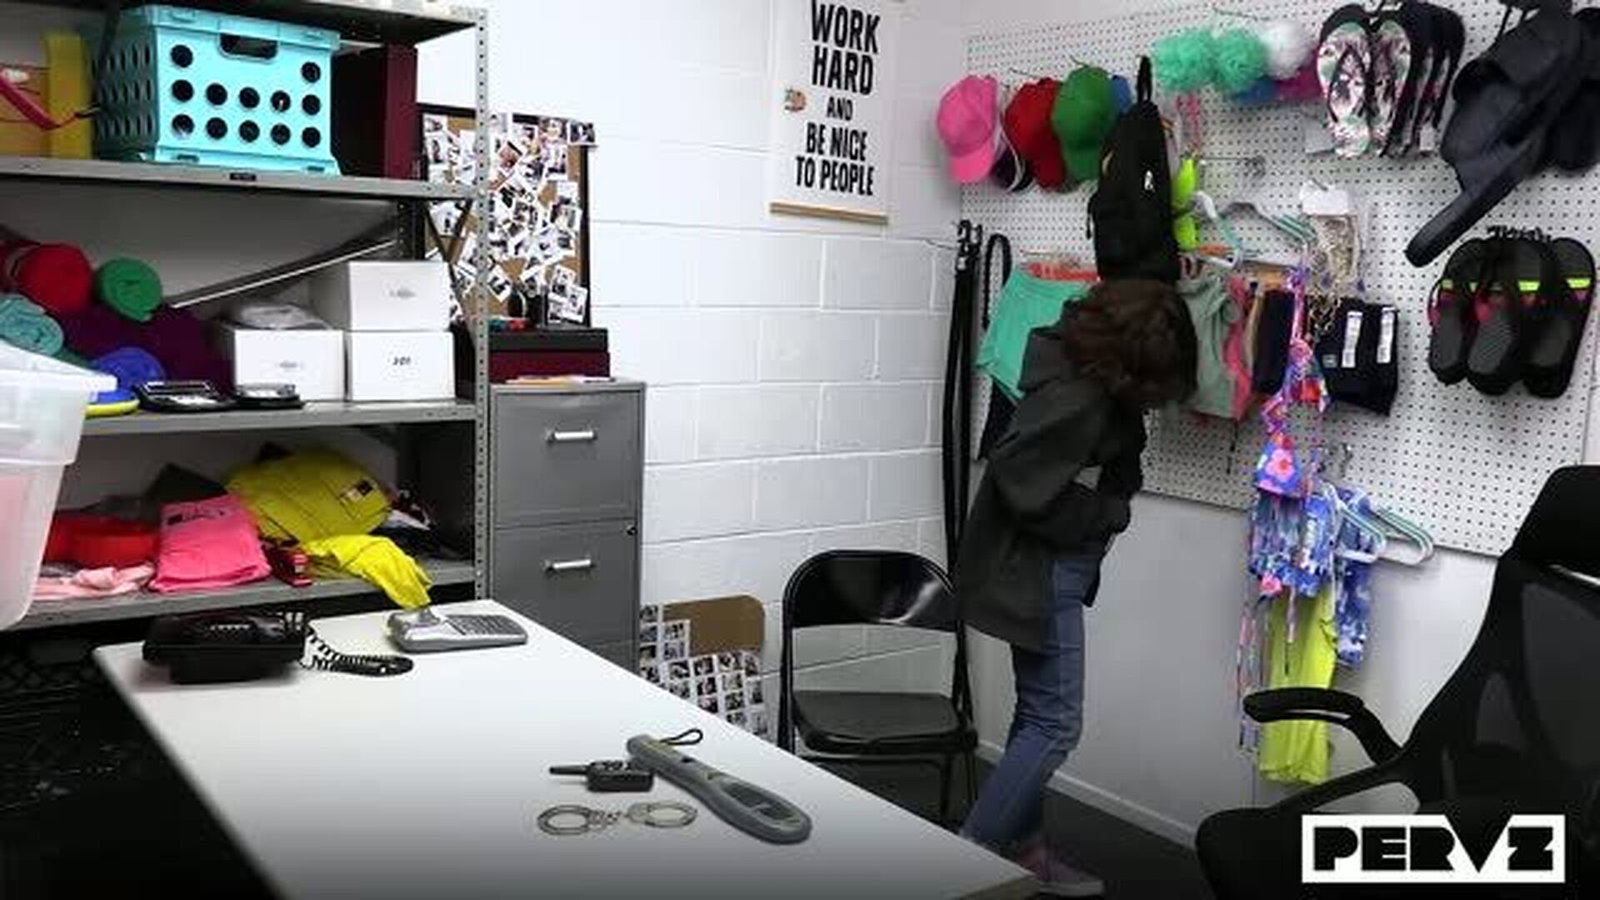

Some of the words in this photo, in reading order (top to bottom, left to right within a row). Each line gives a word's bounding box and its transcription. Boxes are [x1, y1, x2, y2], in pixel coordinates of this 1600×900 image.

[811, 0, 880, 54] WORK
[812, 45, 874, 95] HARD
[826, 97, 853, 121] AND
[807, 122, 826, 155] BE
[830, 127, 867, 162] NICE
[796, 156, 815, 188] TO
[820, 159, 874, 196] PEOPLE
